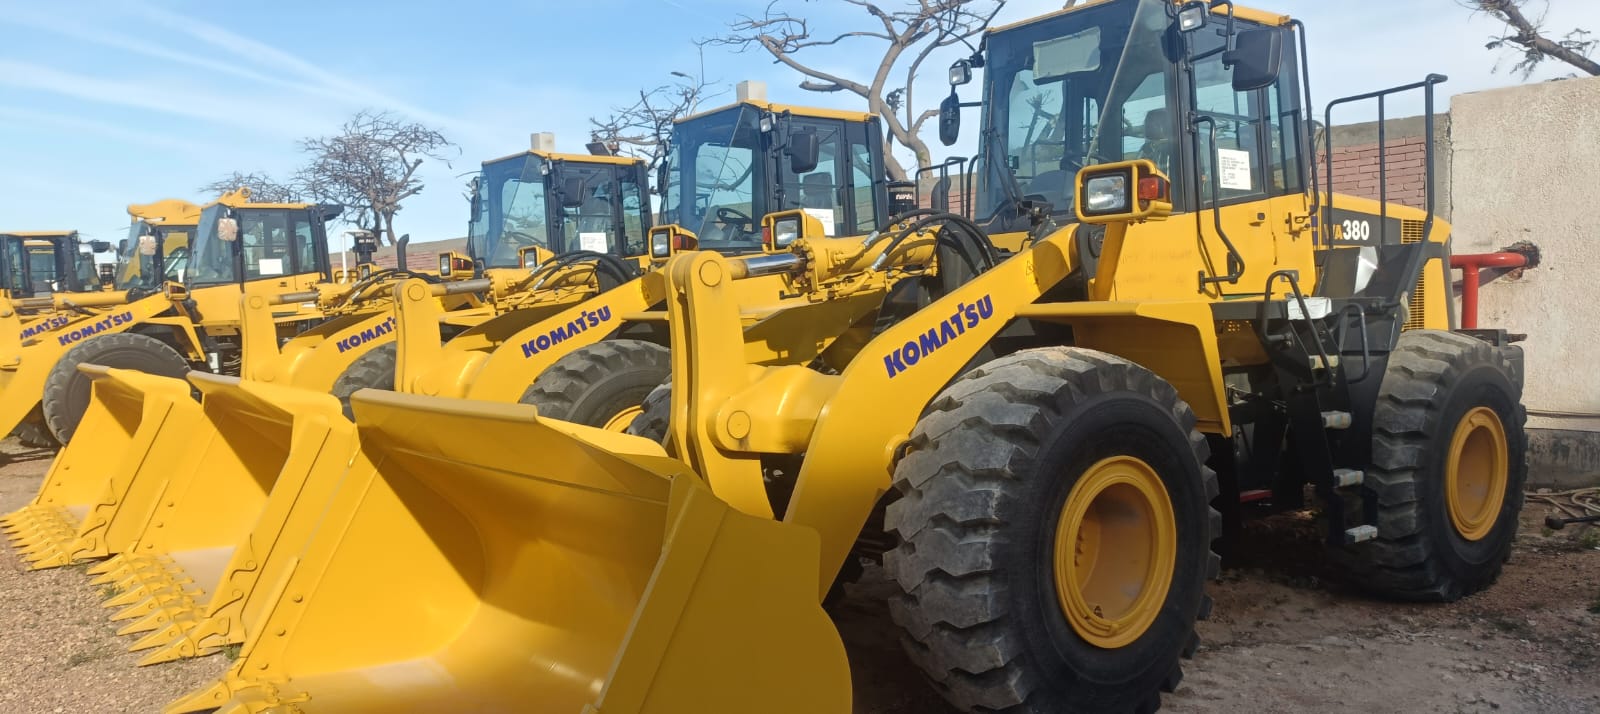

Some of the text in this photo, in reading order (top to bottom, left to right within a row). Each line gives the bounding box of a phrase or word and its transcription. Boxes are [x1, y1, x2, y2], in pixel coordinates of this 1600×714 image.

[20, 315, 69, 340] MATSU
[58, 311, 133, 346] KOMATSU
[520, 305, 612, 359] KOMATSU
[883, 294, 994, 379] KOMATSU
